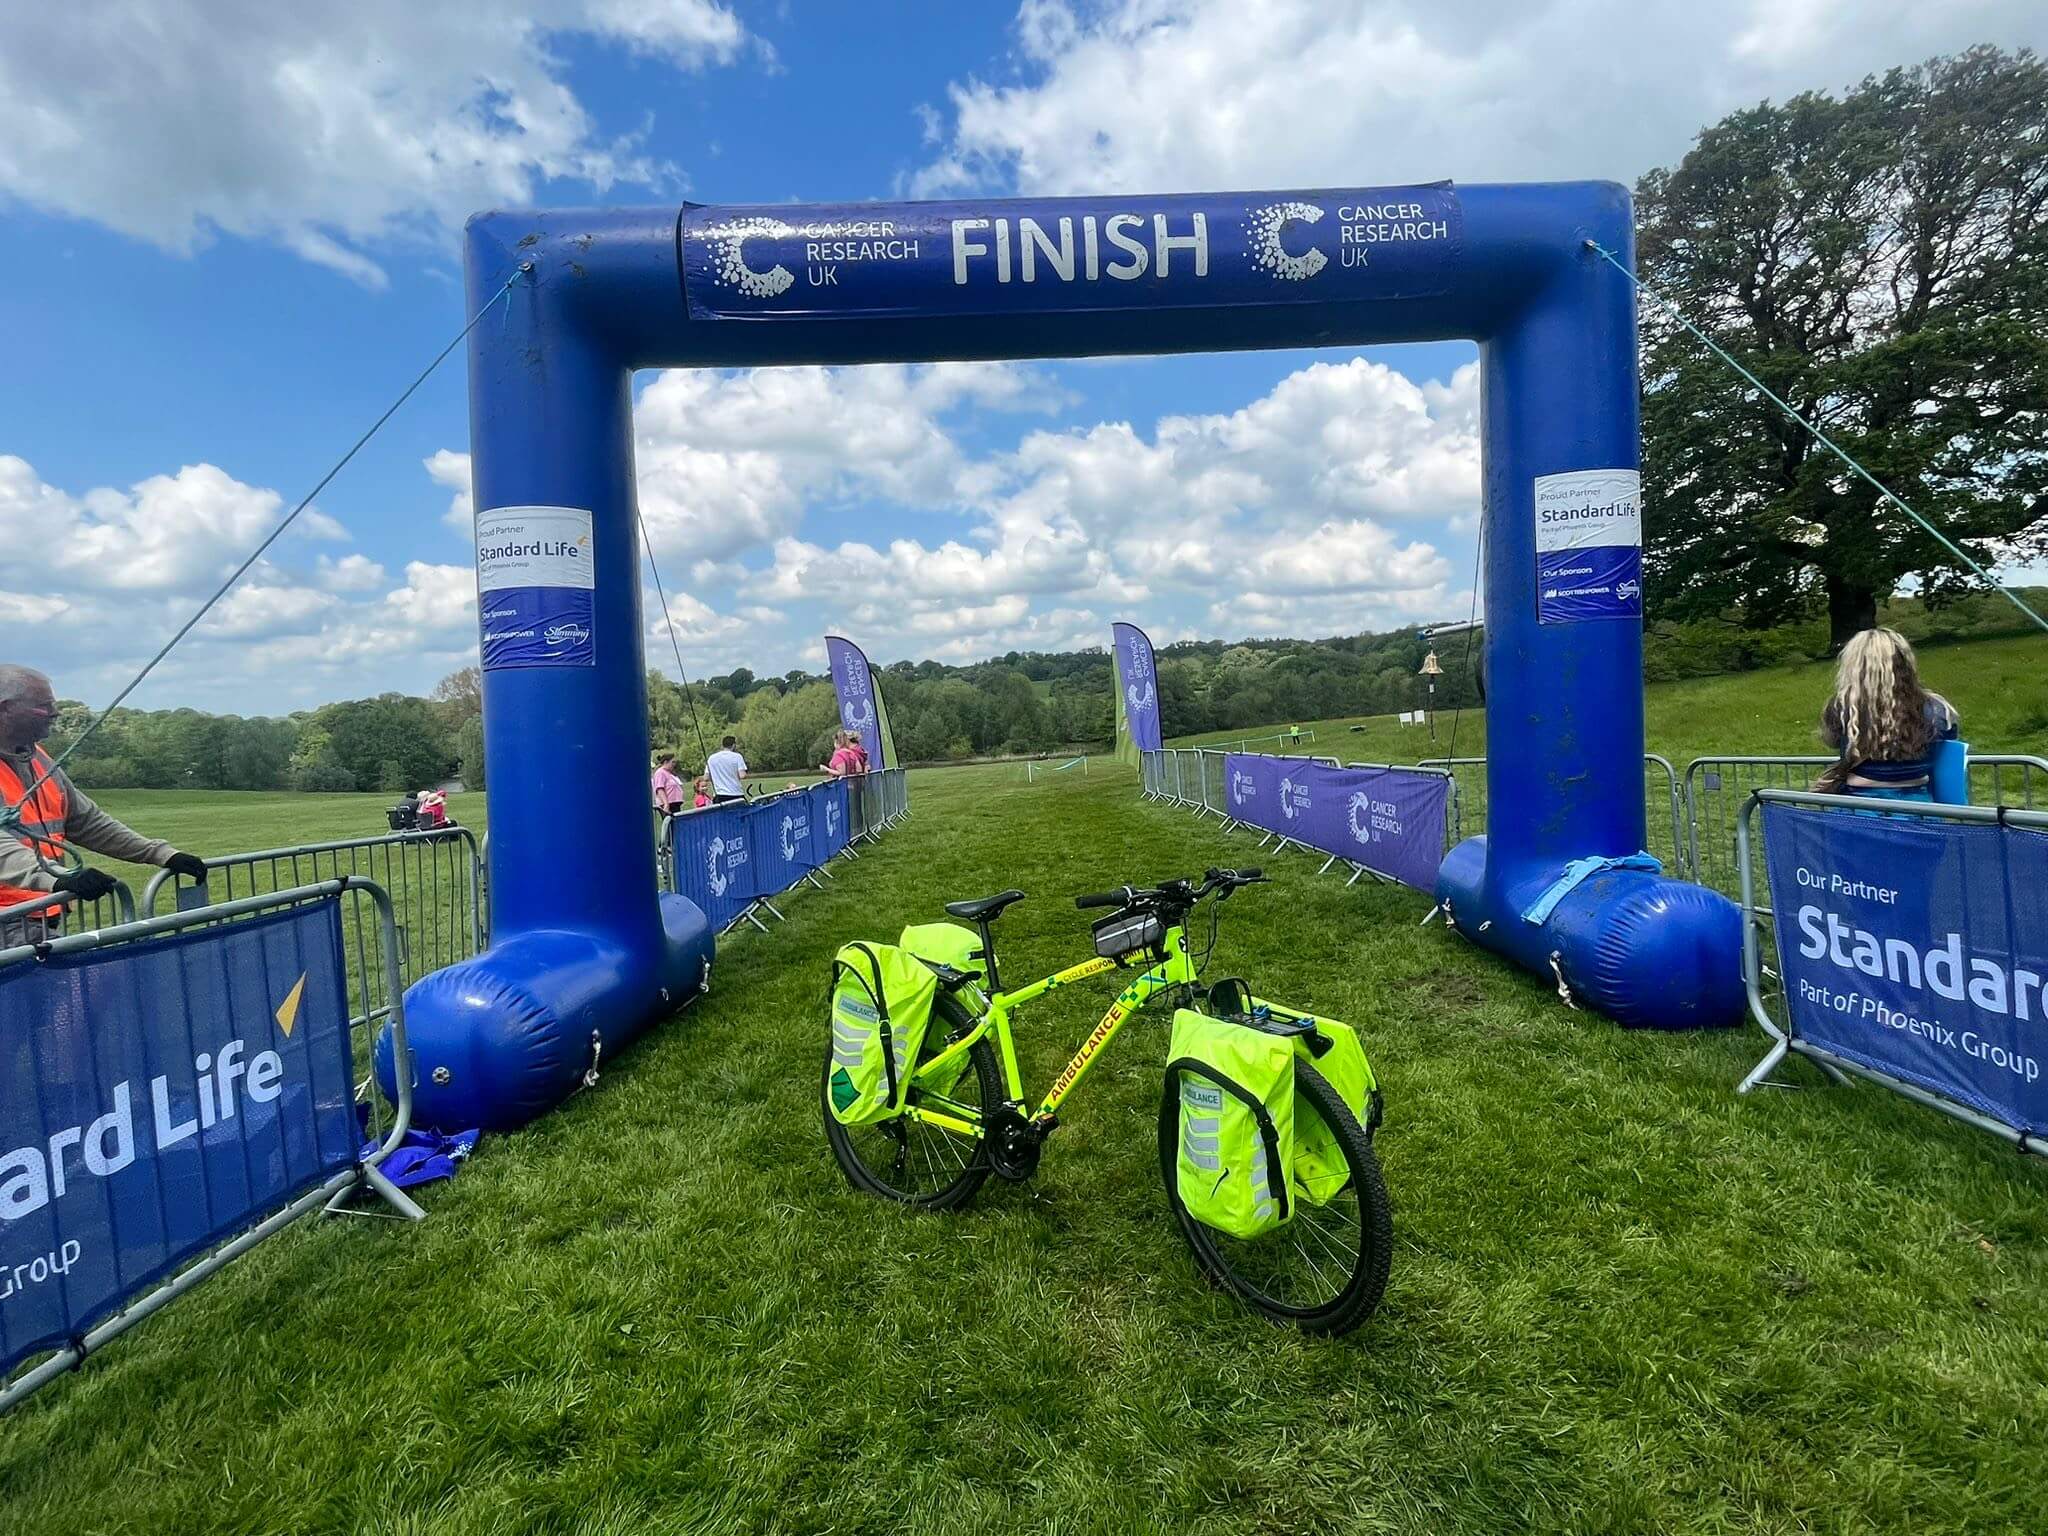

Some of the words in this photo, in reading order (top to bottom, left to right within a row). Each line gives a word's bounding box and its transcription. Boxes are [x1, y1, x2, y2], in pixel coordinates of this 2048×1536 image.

[1338, 204, 1424, 222] CANCER
[806, 221, 896, 239] CANCER
[1340, 220, 1448, 244] RESEARCH
[806, 240, 919, 262] RESEARCH
[951, 213, 1209, 285] FINISH
[1341, 247, 1369, 268] UK
[808, 265, 839, 286] UK
[1541, 491, 1568, 501] Proud
[1569, 488, 1602, 498] Partner
[1541, 503, 1615, 523] Standard
[1616, 502, 1635, 517] Life
[495, 526, 525, 535] Partner
[480, 541, 541, 561] Standard
[544, 541, 578, 558] Life
[1371, 800, 1397, 818] CANCER
[1371, 815, 1402, 836] RESEARCH
[1796, 867, 1826, 890] Our
[1831, 874, 1898, 905] Partner
[1063, 969, 1085, 983] CYCLE
[1085, 959, 1115, 974] RESPON
[1798, 904, 2048, 1021] Standar
[1800, 978, 1830, 1008] Part
[1834, 992, 1858, 1014] of
[1861, 997, 1956, 1050] Phoenix
[1961, 1031, 2039, 1083] Group
[1050, 1006, 1122, 1102] AMBULANCE
[151, 1039, 284, 1150] Life
